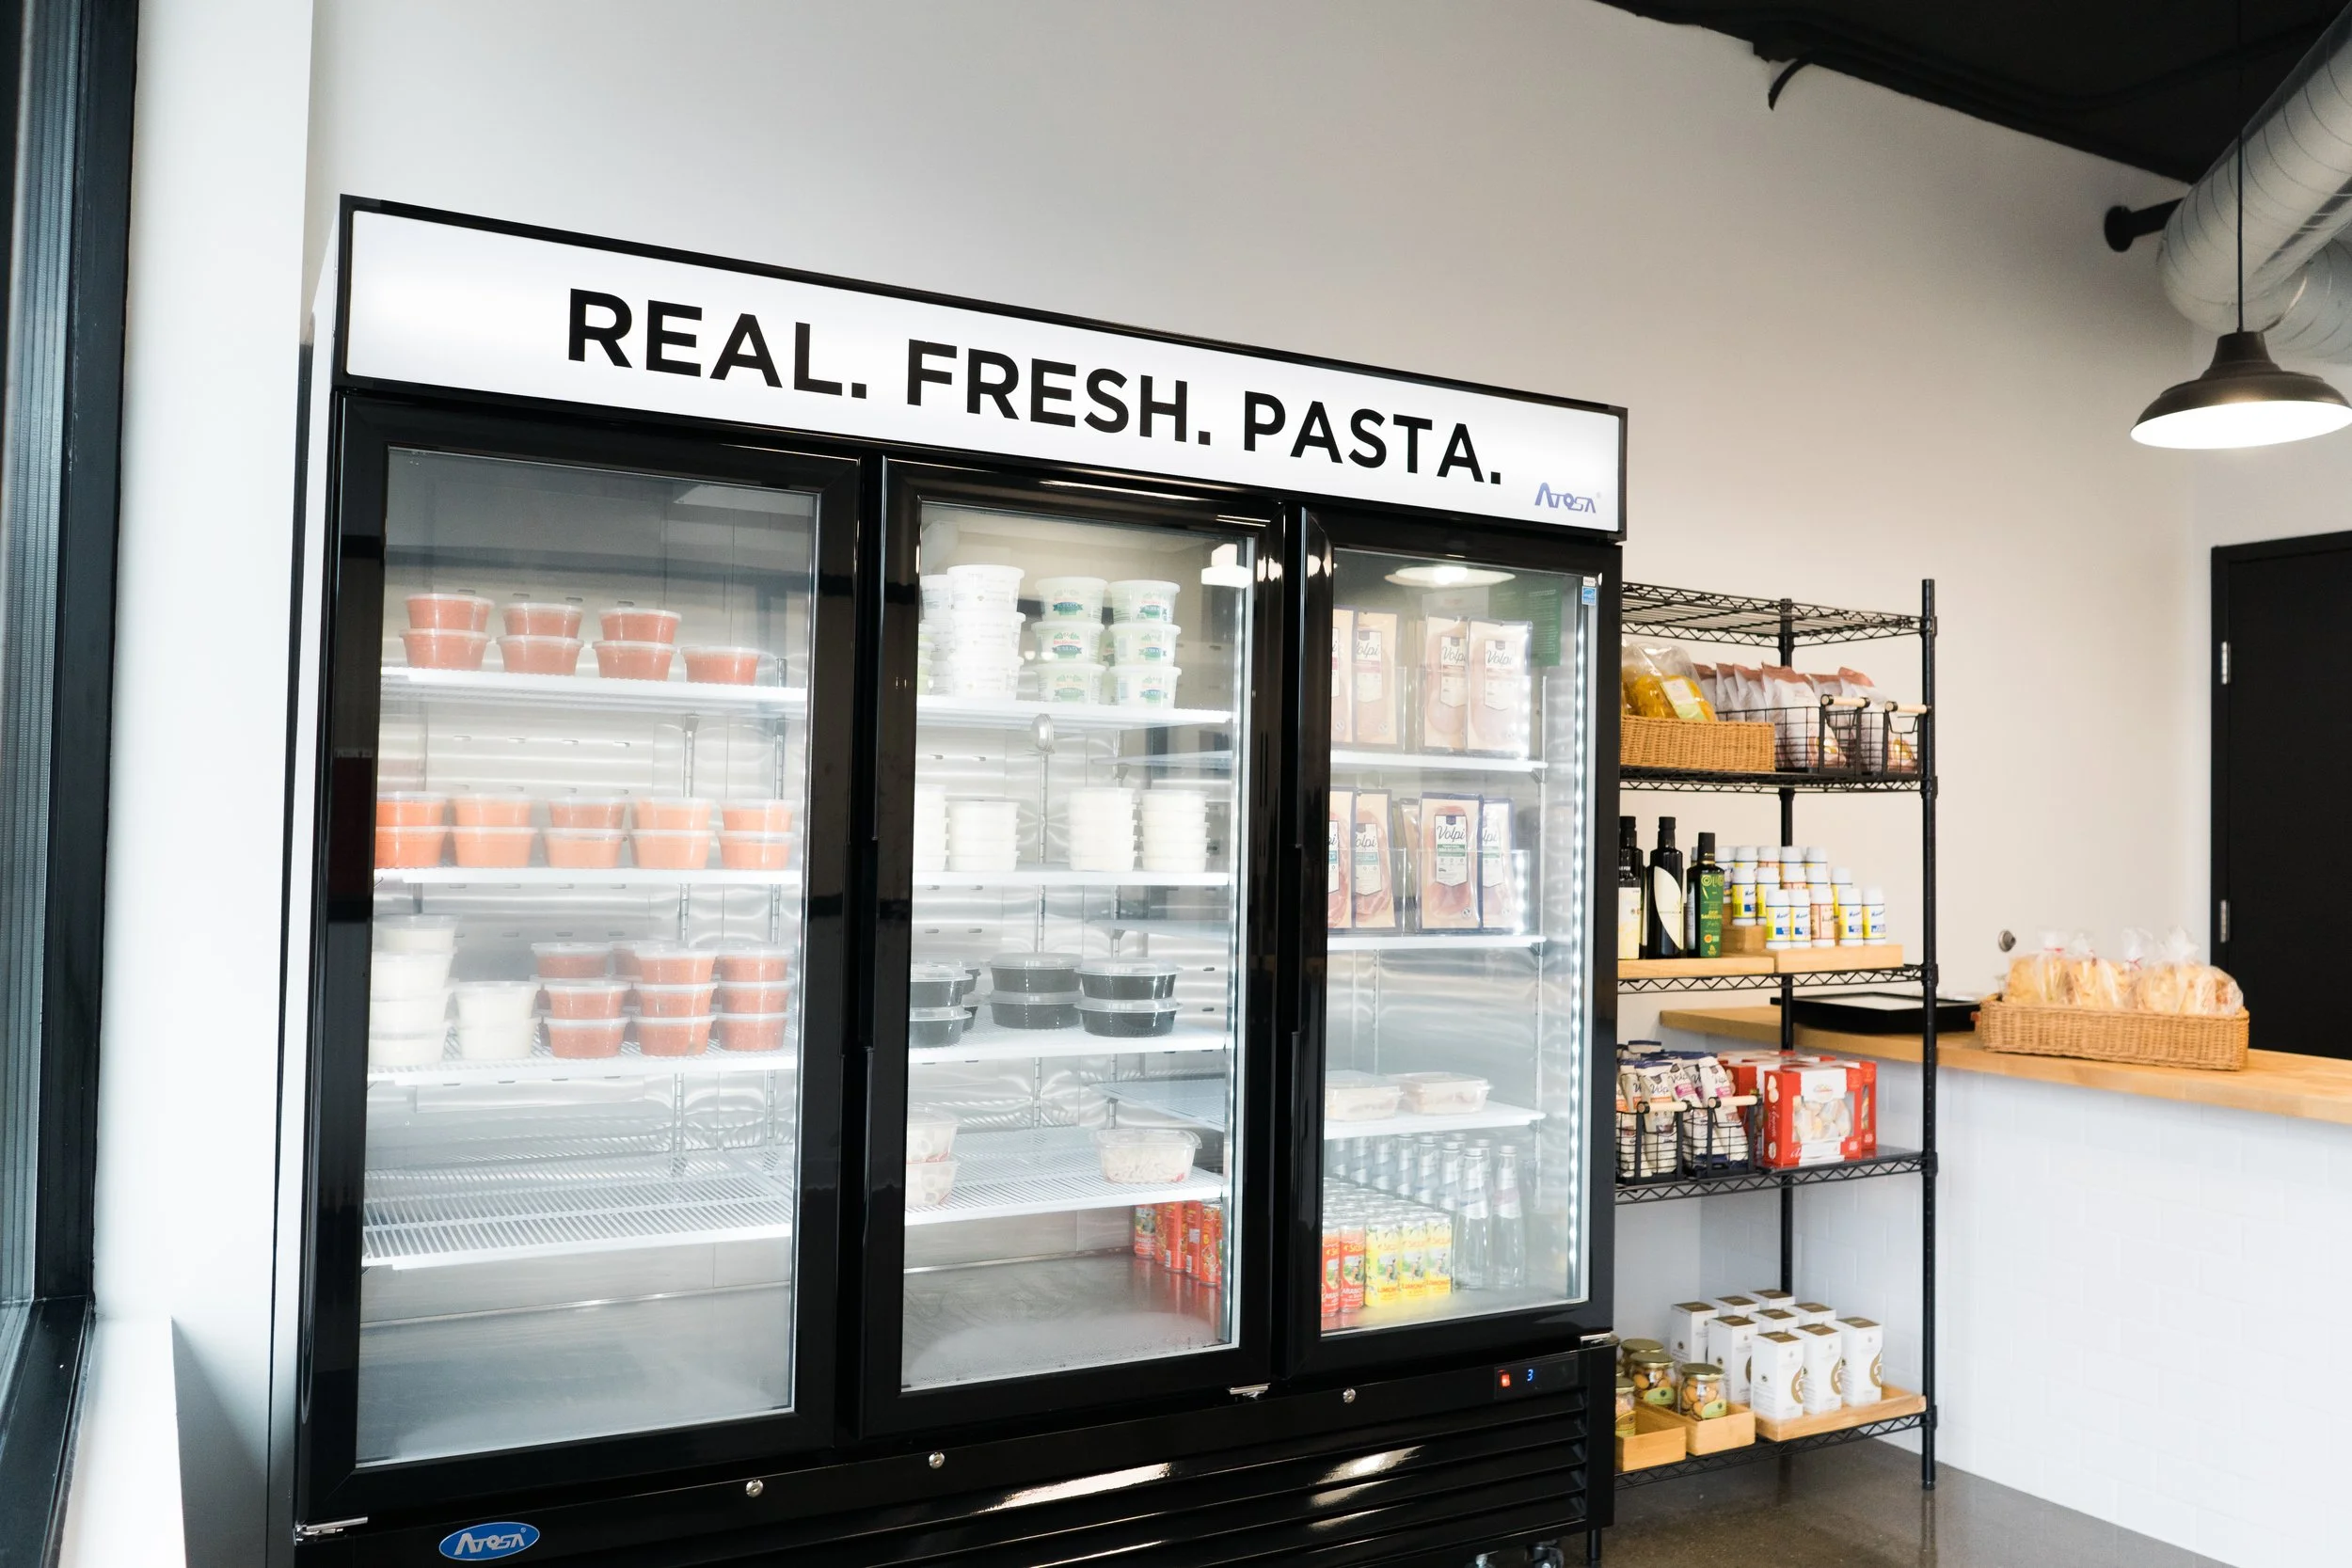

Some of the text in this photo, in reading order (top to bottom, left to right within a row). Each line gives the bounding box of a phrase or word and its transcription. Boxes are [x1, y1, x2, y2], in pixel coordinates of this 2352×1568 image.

[568, 288, 1502, 486] REAL. FRESH. PASTA.
[1356, 641, 1379, 658] olpi
[1356, 833, 1377, 849] olpi
[1437, 825, 1465, 843] Volpi
[1526, 1368, 1534, 1382] 3
